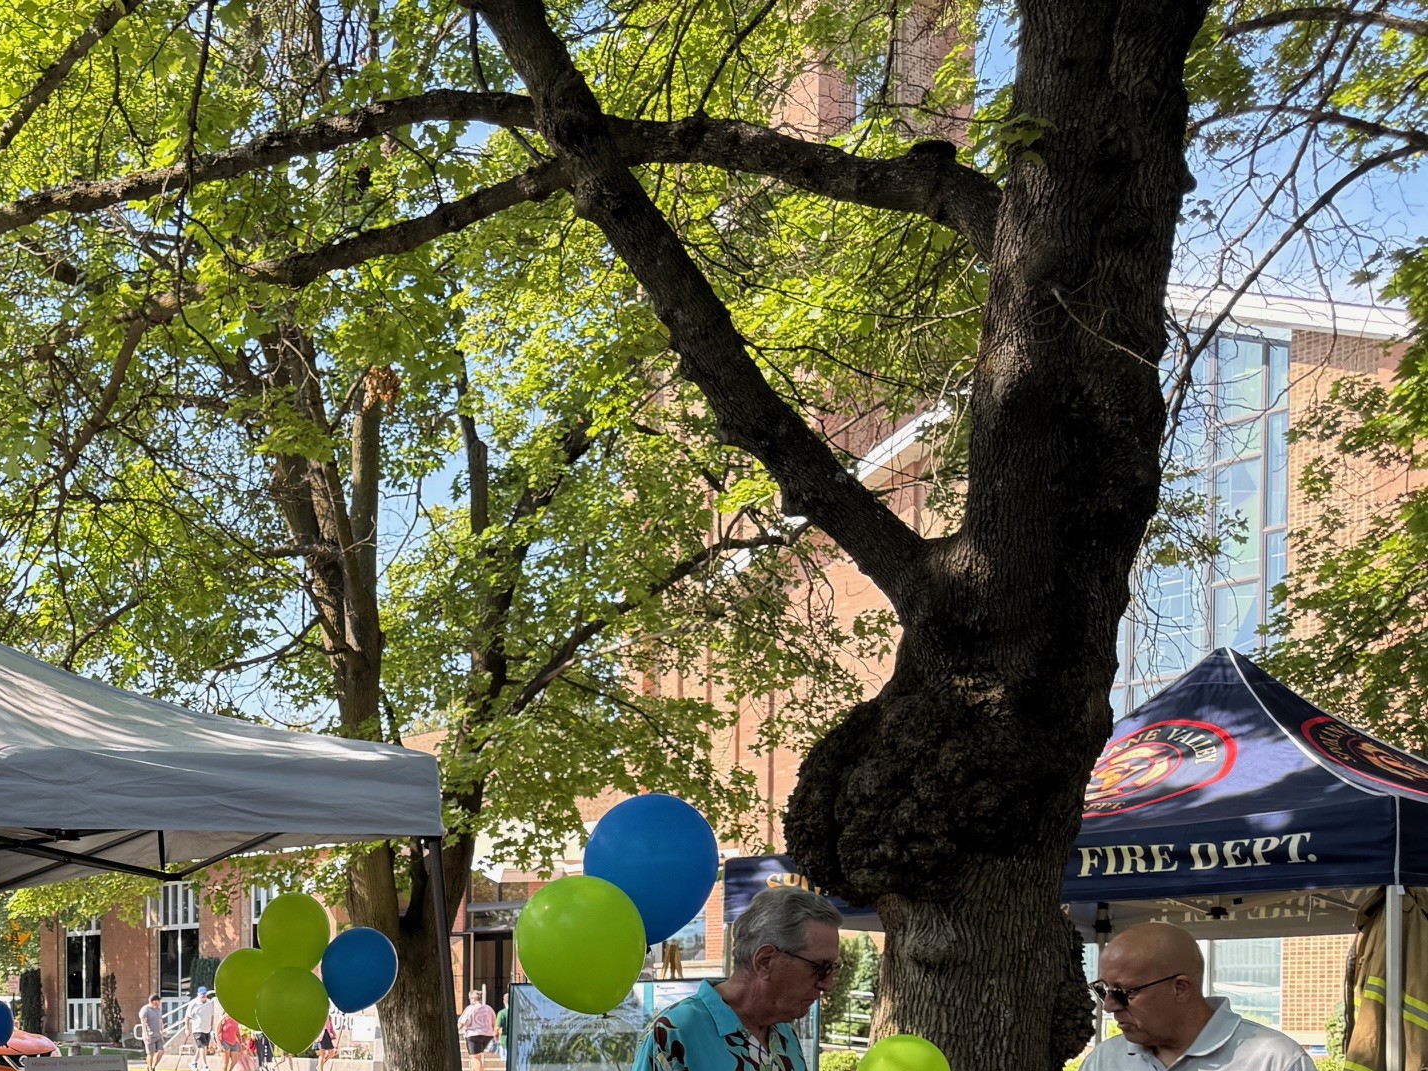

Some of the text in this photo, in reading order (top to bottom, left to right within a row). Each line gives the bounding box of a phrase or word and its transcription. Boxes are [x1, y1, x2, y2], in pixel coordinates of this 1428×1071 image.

[1166, 728, 1217, 764] VALLEY
[1076, 832, 1318, 878] FIRE DEPT.
